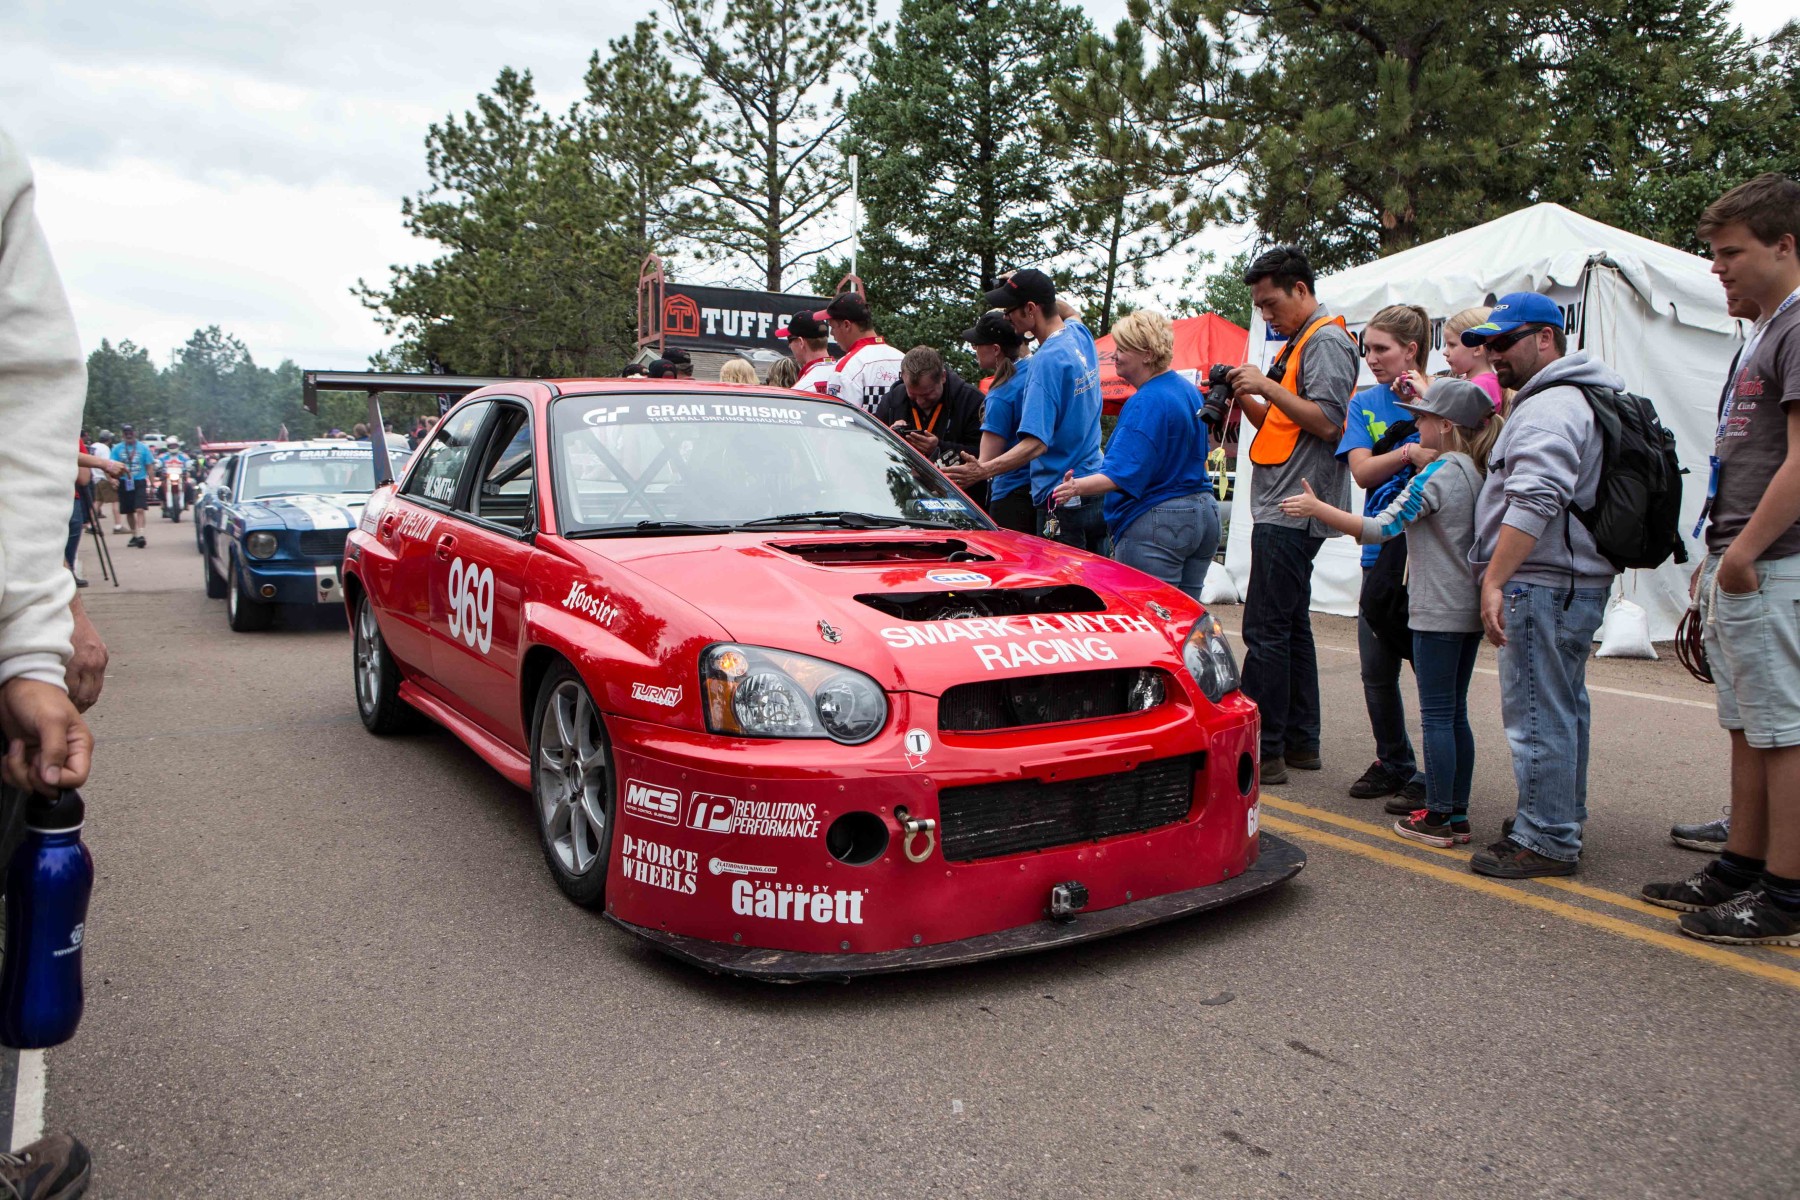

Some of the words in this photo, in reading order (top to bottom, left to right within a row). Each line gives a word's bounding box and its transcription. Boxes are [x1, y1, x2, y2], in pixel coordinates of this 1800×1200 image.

[701, 307, 773, 339] TUFF
[646, 404, 706, 417] GRAN
[711, 404, 803, 420] TURISMO
[745, 416, 804, 425] SIMULATOR
[300, 450, 329, 459] GRAN
[931, 574, 986, 582] Gulf
[448, 556, 494, 655] 969
[561, 580, 619, 627] Hoosier
[880, 614, 1024, 649] SMARK
[1026, 614, 1060, 635] A
[1057, 613, 1159, 635] MYTH
[972, 637, 1118, 671] RACING
[627, 784, 679, 813] MCS
[735, 800, 817, 820] REVOLUTIONS
[732, 817, 821, 838] PERFORMANCE
[622, 834, 699, 873] D-FORCE
[622, 856, 697, 895] WHEELS
[755, 880, 804, 893] TURBO
[813, 884, 830, 893] BY
[731, 879, 864, 925] Garrett
